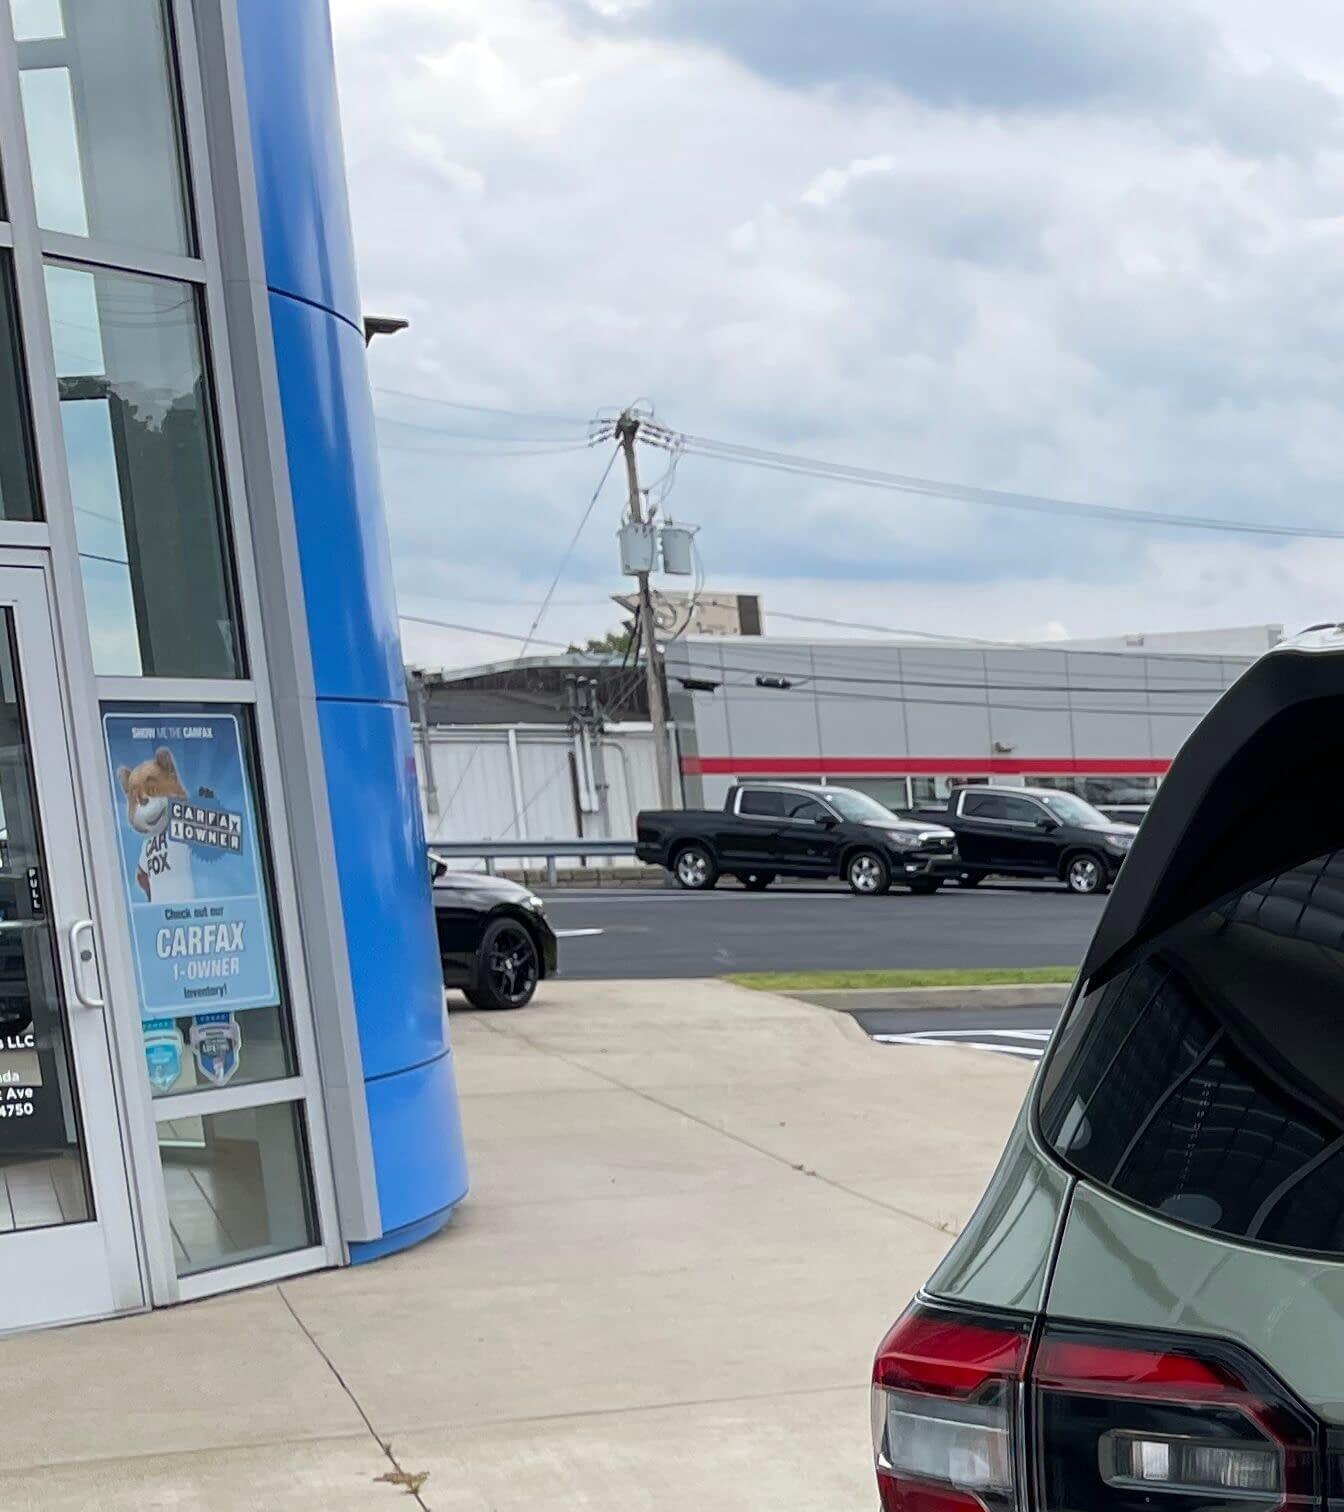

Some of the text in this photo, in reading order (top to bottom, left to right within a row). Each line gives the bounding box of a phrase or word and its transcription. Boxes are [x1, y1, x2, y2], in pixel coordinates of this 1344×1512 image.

[182, 727, 214, 739] CARFAX
[173, 803, 240, 833] CARFAX
[146, 832, 168, 857] CAR
[148, 852, 171, 875] FOX
[29, 868, 40, 909] PULL
[165, 908, 192, 921] Check
[194, 906, 208, 918] out
[156, 921, 245, 959] CARFAX
[173, 957, 240, 981] 1-OWNER
[184, 982, 227, 999] Inventory!
[7, 1034, 35, 1049] LLC
[7, 1087, 34, 1100] Ave
